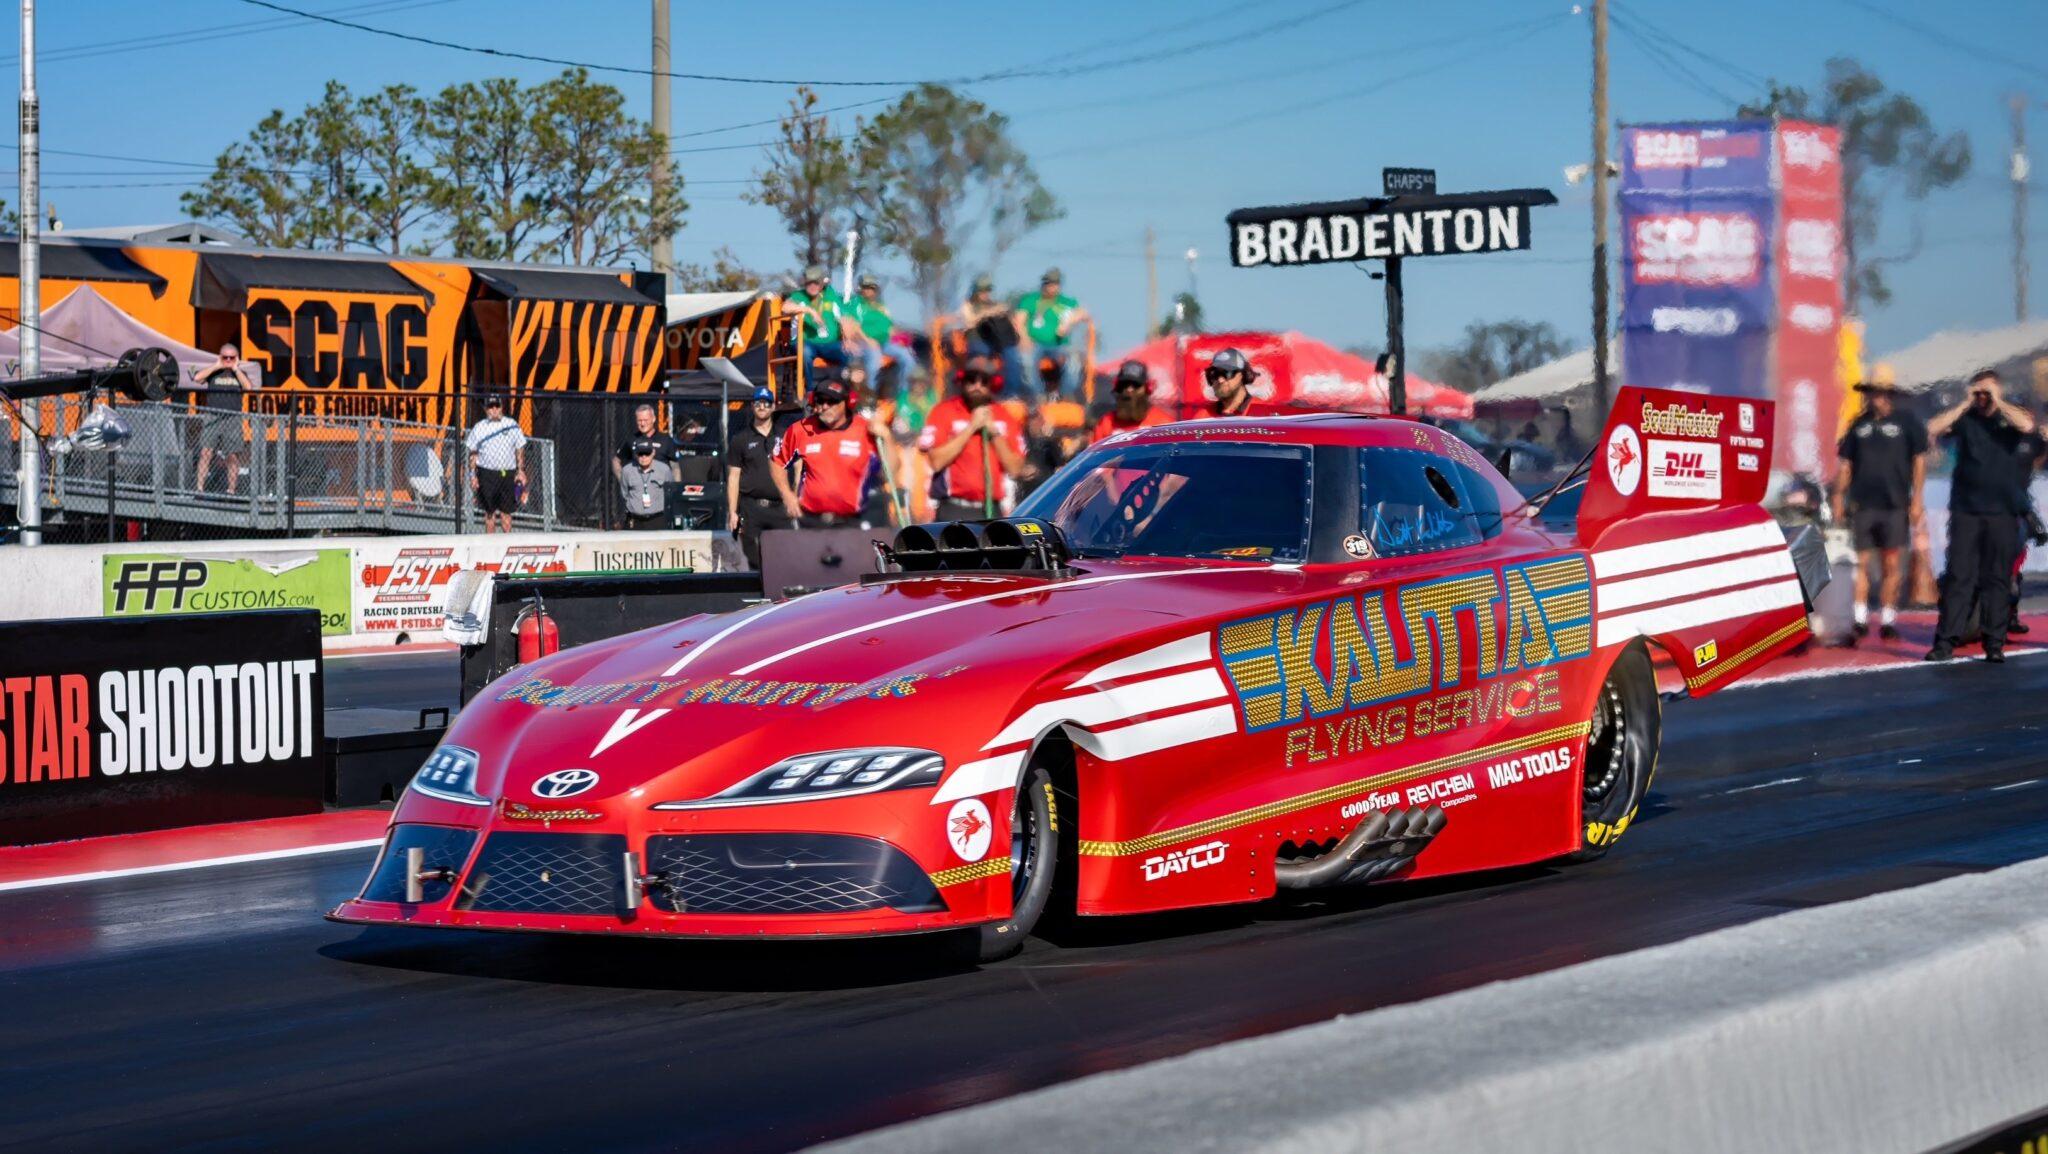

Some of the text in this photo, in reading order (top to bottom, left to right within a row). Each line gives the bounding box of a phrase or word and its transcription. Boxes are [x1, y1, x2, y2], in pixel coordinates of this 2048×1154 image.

[1387, 173, 1422, 190] CHAPS
[1237, 207, 1519, 266] BRADENTON
[247, 298, 427, 390] SCAG
[666, 327, 744, 348] OYOTA
[248, 393, 429, 428] POWER EQUIPMENT
[1665, 451, 1705, 477] DHL
[593, 547, 697, 570] TUSCANY TILE
[1346, 540, 1368, 553] 319
[112, 560, 208, 613] FFP
[378, 556, 448, 593] PST
[364, 607, 398, 616] RACING
[401, 617, 445, 628] PSTDS.C
[1277, 567, 1556, 722] KALITTA
[0, 659, 316, 786] TAR SHOOTOUT
[1285, 669, 1561, 768] FLYING SERVICE
[1487, 746, 1571, 789] MAC TOOLS
[1341, 792, 1400, 818] GOODYEAR
[1406, 773, 1475, 806] REVCHEM
[1440, 793, 1477, 808] Composites
[1142, 841, 1229, 881] DAYCO
